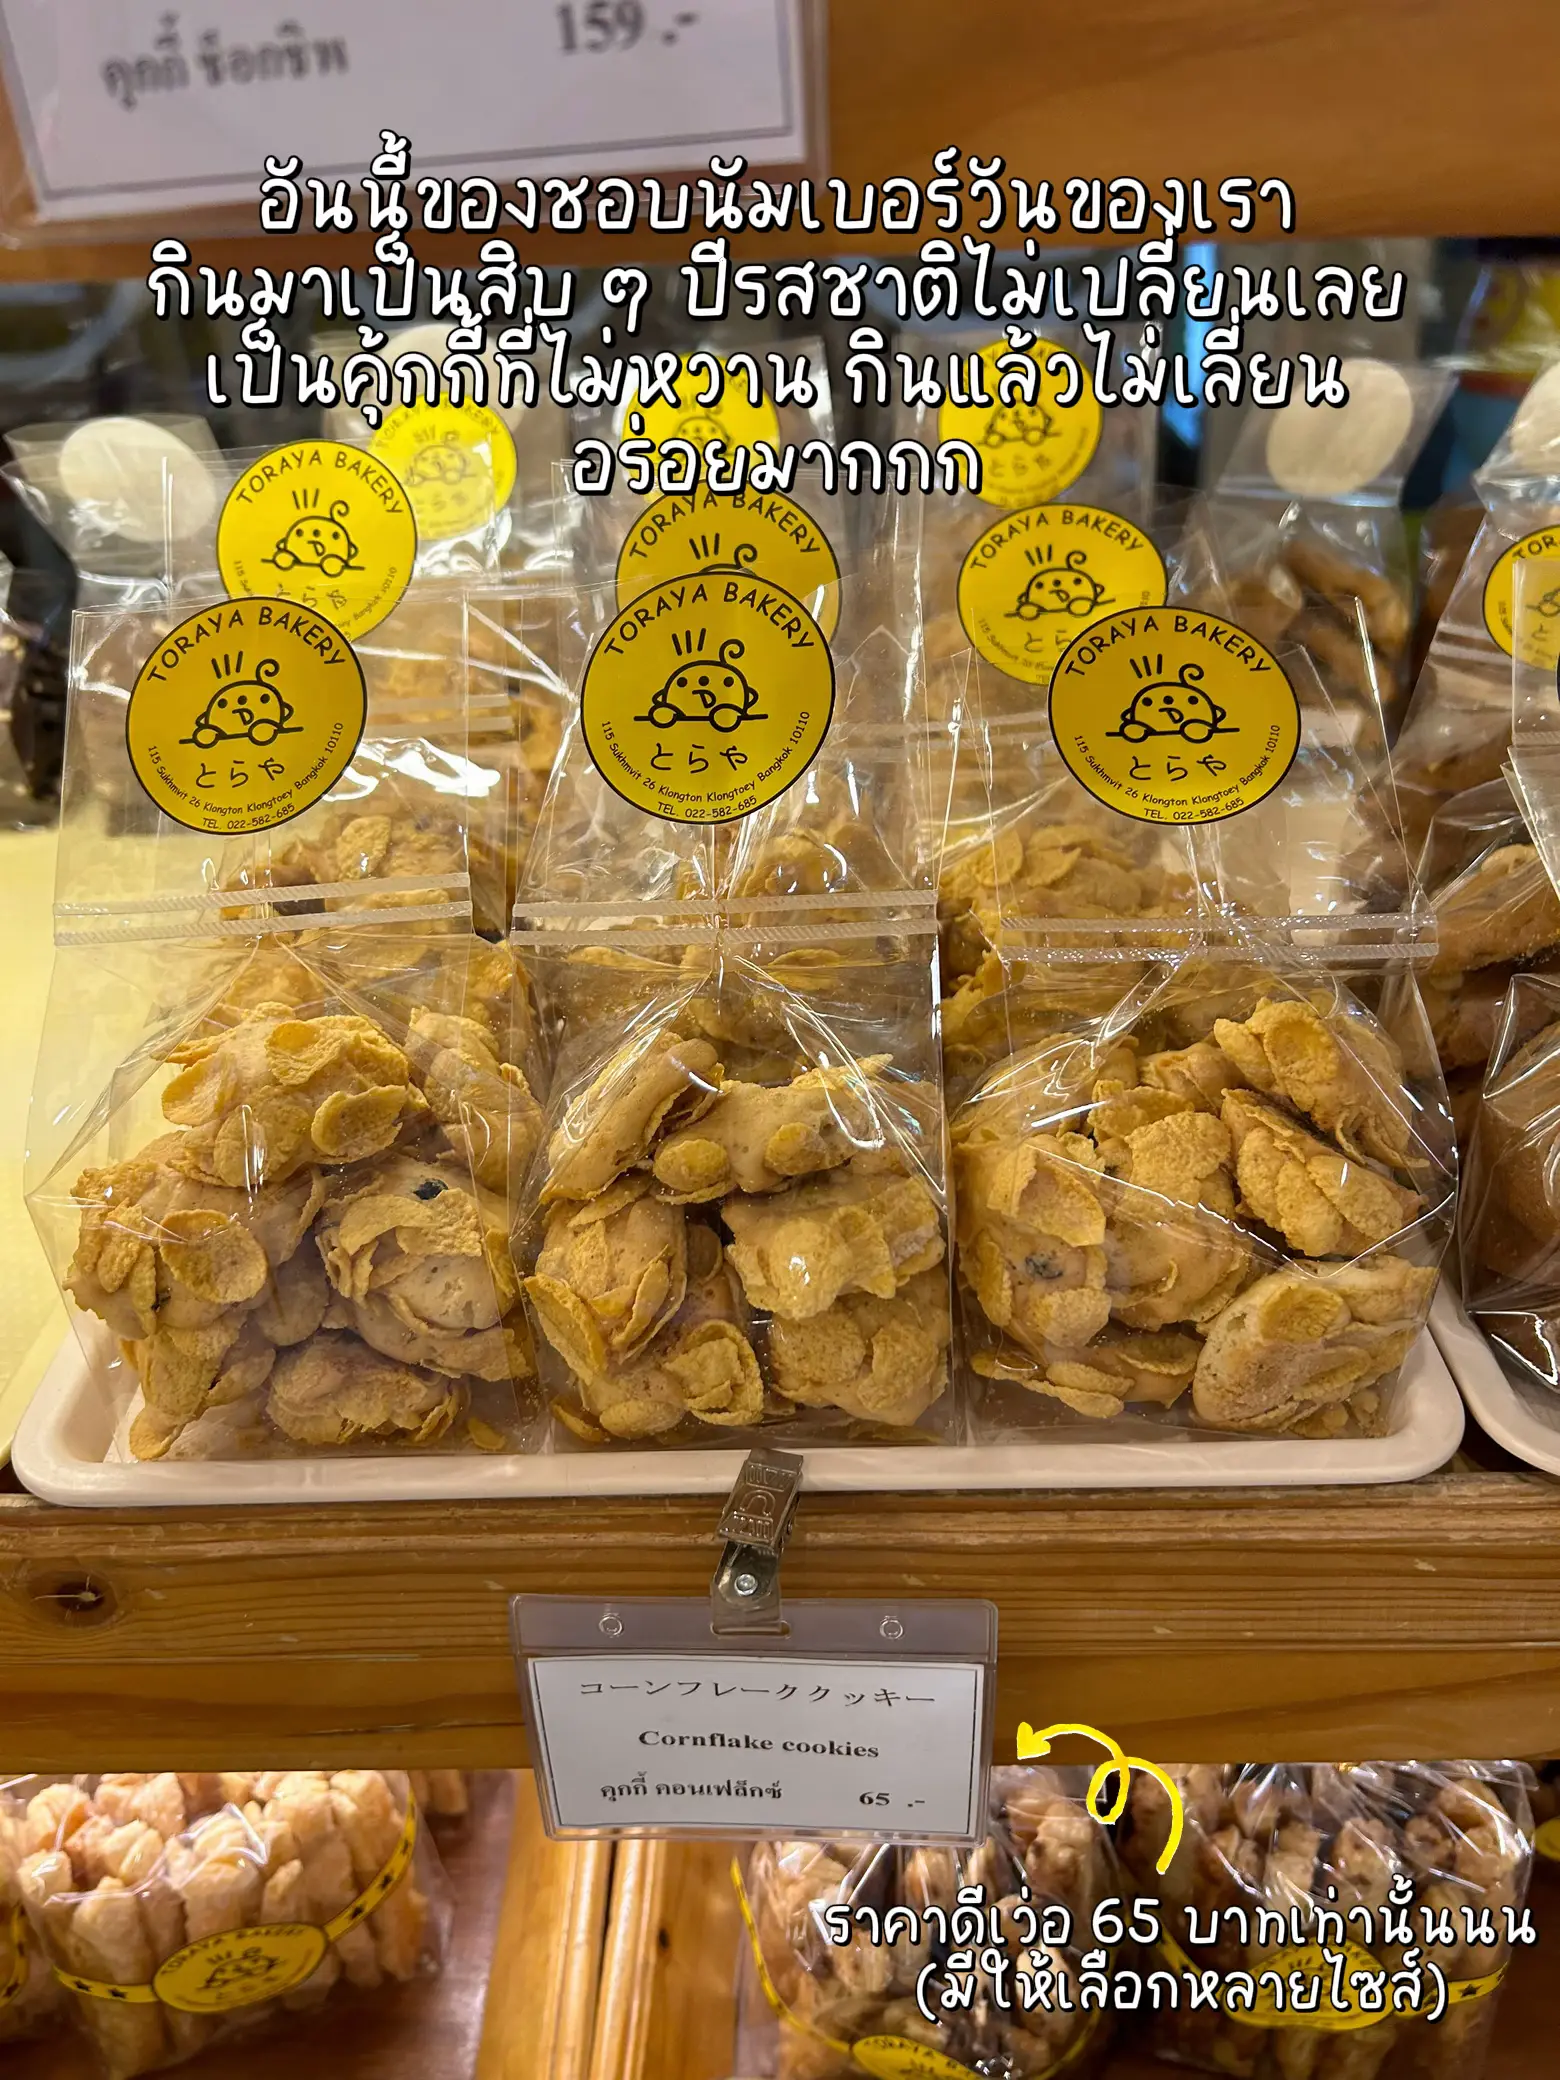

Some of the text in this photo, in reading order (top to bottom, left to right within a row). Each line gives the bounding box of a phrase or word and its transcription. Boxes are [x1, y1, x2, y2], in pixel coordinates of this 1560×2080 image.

[555, 0, 645, 55] 159
[236, 449, 404, 514] TORAYA BAKERY
[628, 490, 821, 559] TORAYA BAKERY
[969, 509, 1145, 570] TORAYA BAKERY
[146, 606, 346, 682] TORAYA BAKERY
[603, 581, 815, 654] TORAYA BAKERY
[1064, 615, 1271, 676] TORAYA BAKERY
[148, 745, 162, 765] 115
[188, 796, 201, 808] 26
[203, 802, 243, 817] Klongton
[247, 789, 294, 812] Klongtoey
[294, 756, 328, 790] Bangkok
[324, 722, 344, 754] 10110
[195, 757, 285, 789] とらや
[601, 720, 615, 741] 115
[642, 778, 656, 790] 26
[658, 785, 703, 803] Klongton
[706, 781, 756, 802] Klongtoey
[756, 746, 793, 782] Bangkok
[789, 711, 810, 745] 10110
[650, 743, 748, 774] とらや
[1074, 735, 1088, 753] 115
[1124, 786, 1139, 799] 26
[1142, 794, 1188, 808] Klongton
[1191, 785, 1240, 805] Klongtoey
[1239, 755, 1270, 786] Bangkok
[1265, 724, 1280, 754] 10110
[1128, 754, 1227, 782] とらや
[202, 803, 296, 830] TEL. 022-582-685
[656, 795, 758, 819] TEL. 022-582-685
[1143, 797, 1245, 821] TEL. 022-582-685
[580, 1680, 936, 1708] コーンフレーククッキー
[638, 1730, 880, 1759] Cornflake cookies
[600, 1771, 649, 1802] คุกกี้
[858, 1791, 891, 1807] 65
